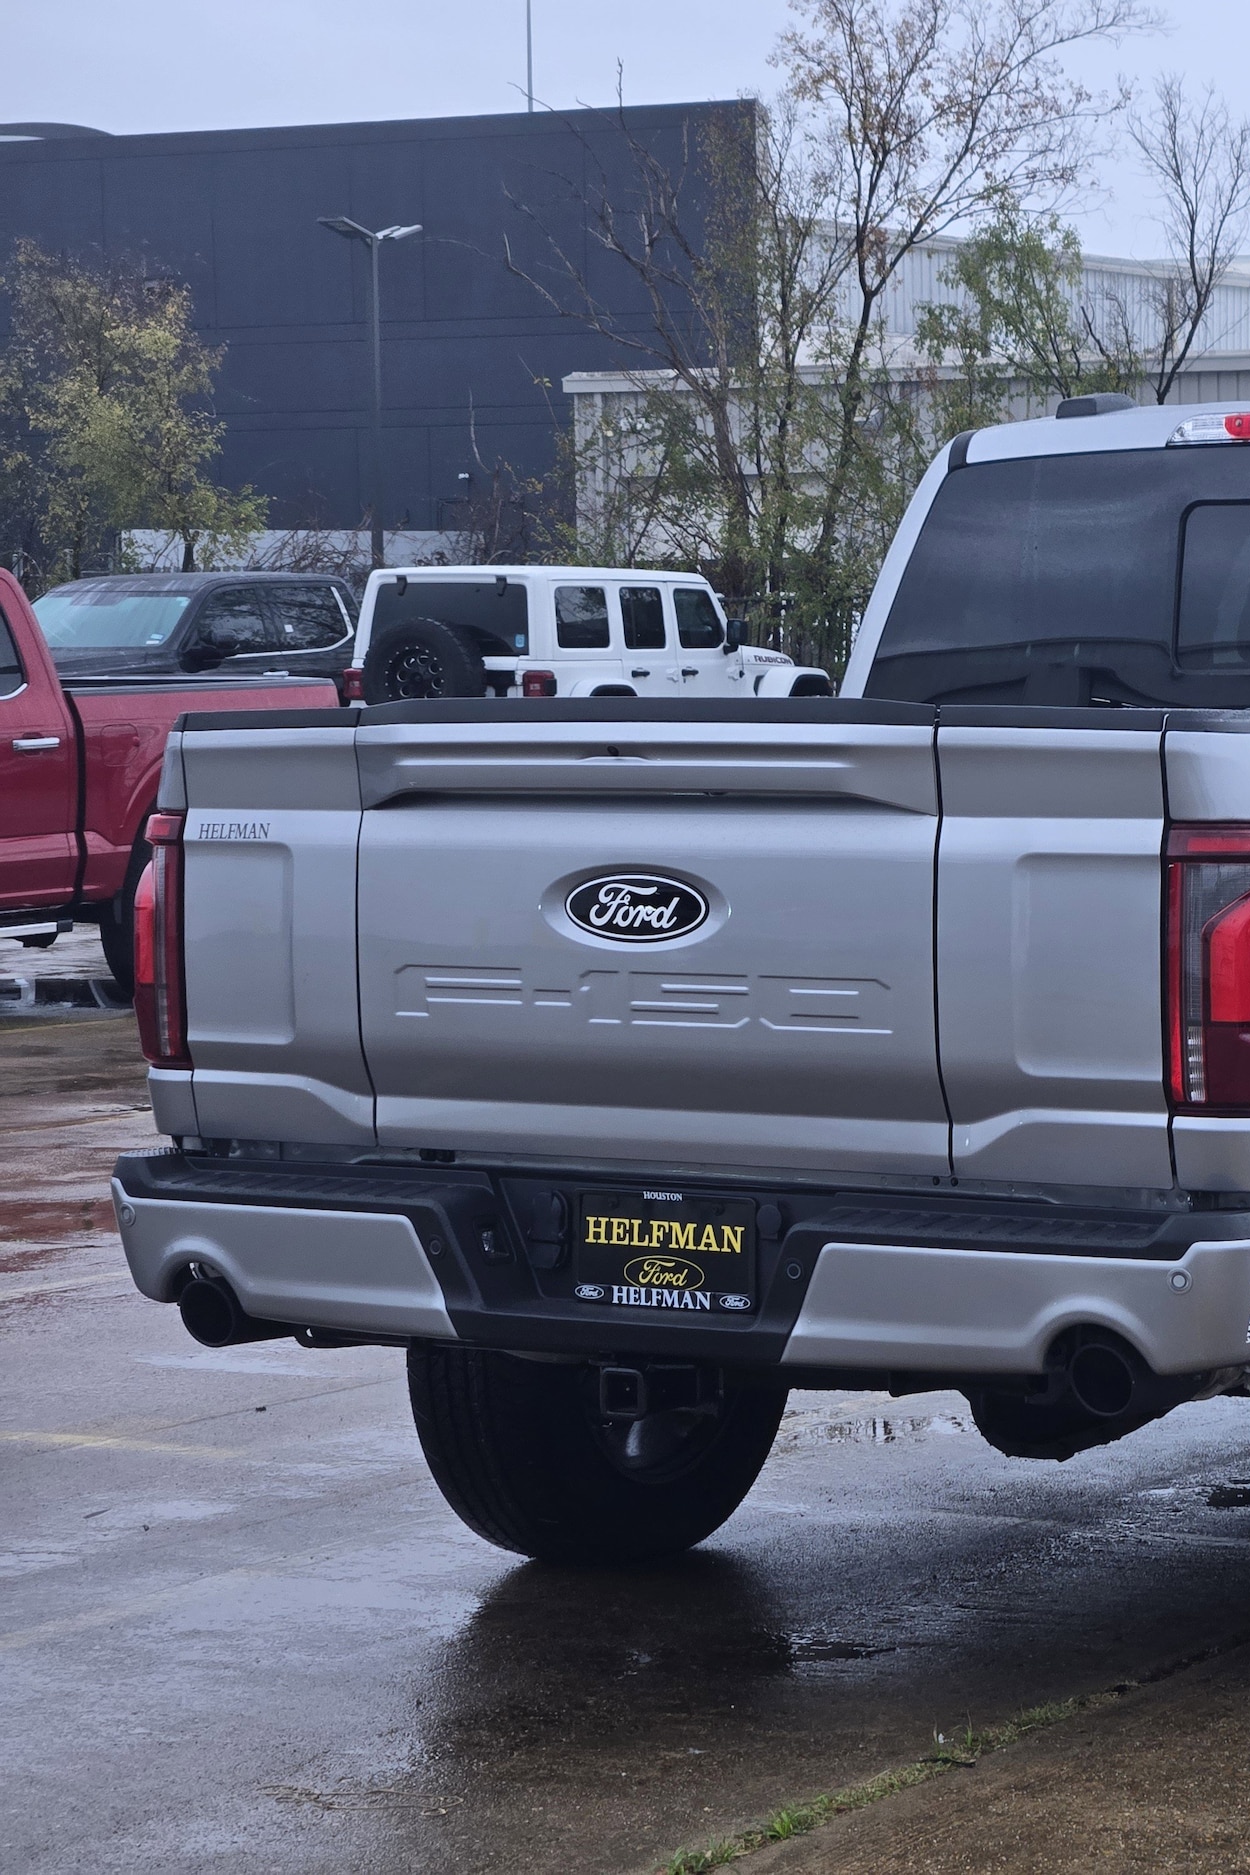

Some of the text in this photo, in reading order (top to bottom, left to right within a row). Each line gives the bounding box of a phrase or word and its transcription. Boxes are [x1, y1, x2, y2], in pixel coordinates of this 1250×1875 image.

[754, 654, 792, 665] RUBICON
[198, 822, 271, 840] HELFMAN
[589, 882, 678, 930] Ford
[394, 964, 893, 1034] F-150
[643, 1190, 683, 1202] HOUSTON
[584, 1215, 745, 1253] HELFMAN
[638, 1259, 689, 1287] Ford
[611, 1284, 712, 1311] HELFMAN
